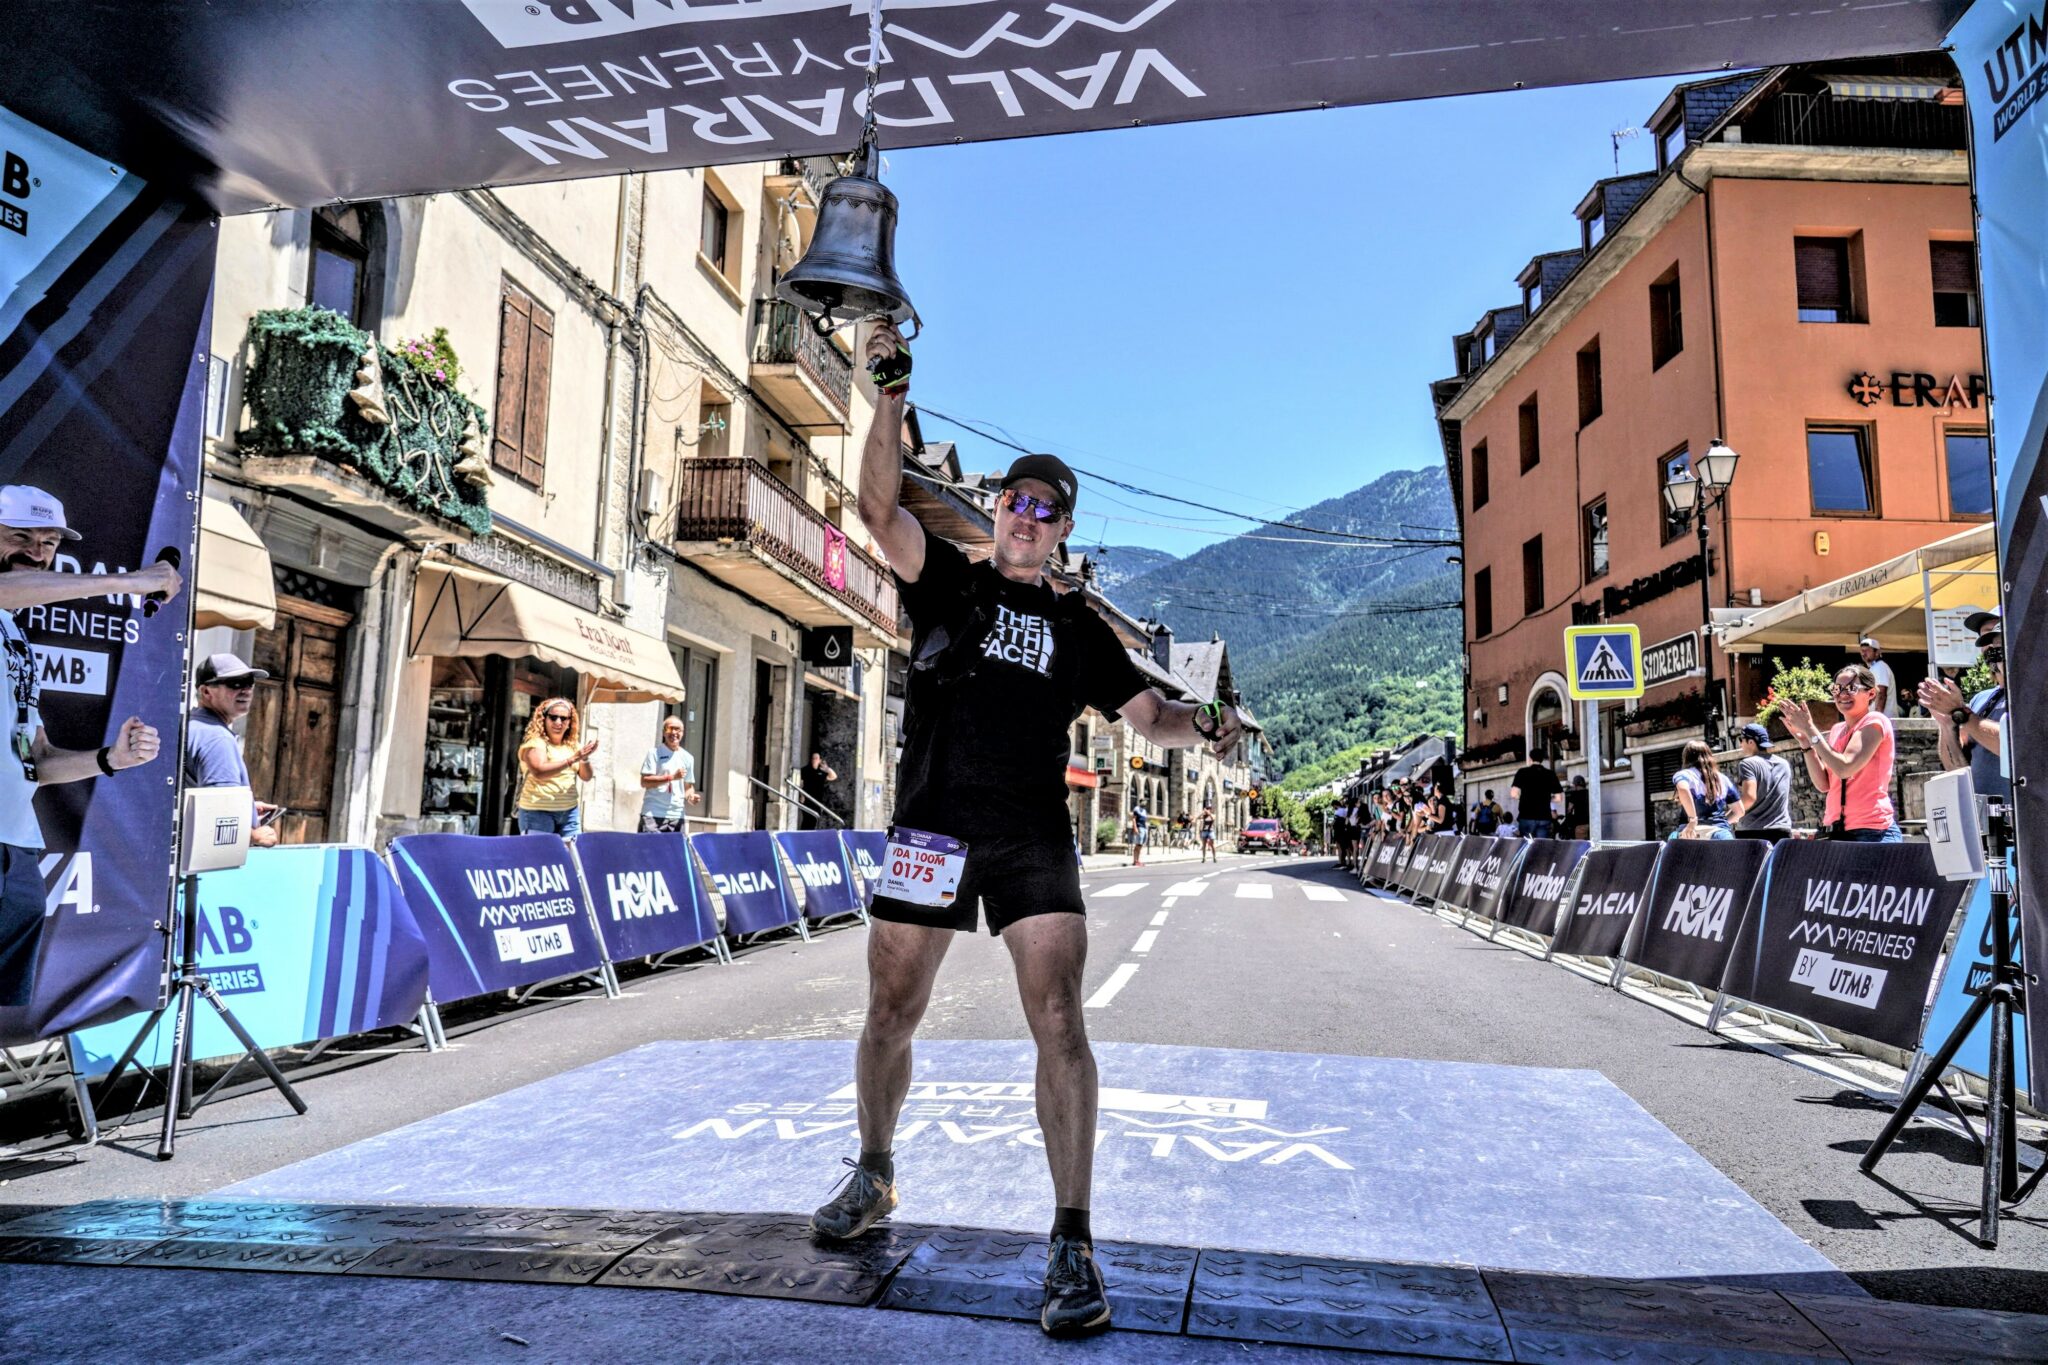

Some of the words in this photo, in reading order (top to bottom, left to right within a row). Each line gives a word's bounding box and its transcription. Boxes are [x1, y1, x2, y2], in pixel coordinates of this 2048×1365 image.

[1997, 82, 2036, 132] WORLD
[997, 604, 1042, 633] THE
[795, 851, 842, 887] wahoo
[892, 860, 935, 883] 0175
[915, 851, 946, 866] 100M
[606, 870, 676, 921] HOKA
[713, 870, 776, 895] DACIA
[887, 878, 905, 888] DANIEL
[1522, 862, 1566, 902] wahoo
[510, 897, 576, 923] PYRENEES
[1576, 891, 1635, 915] DACIA
[1662, 883, 1734, 942] HOKA
[500, 935, 513, 954] BY
[527, 932, 563, 954] UTMB
[1834, 925, 1916, 960] PYRENEES
[1798, 954, 1819, 978] BY
[1829, 967, 1874, 999] UTMB
[1163, 1099, 1237, 1114] BY
